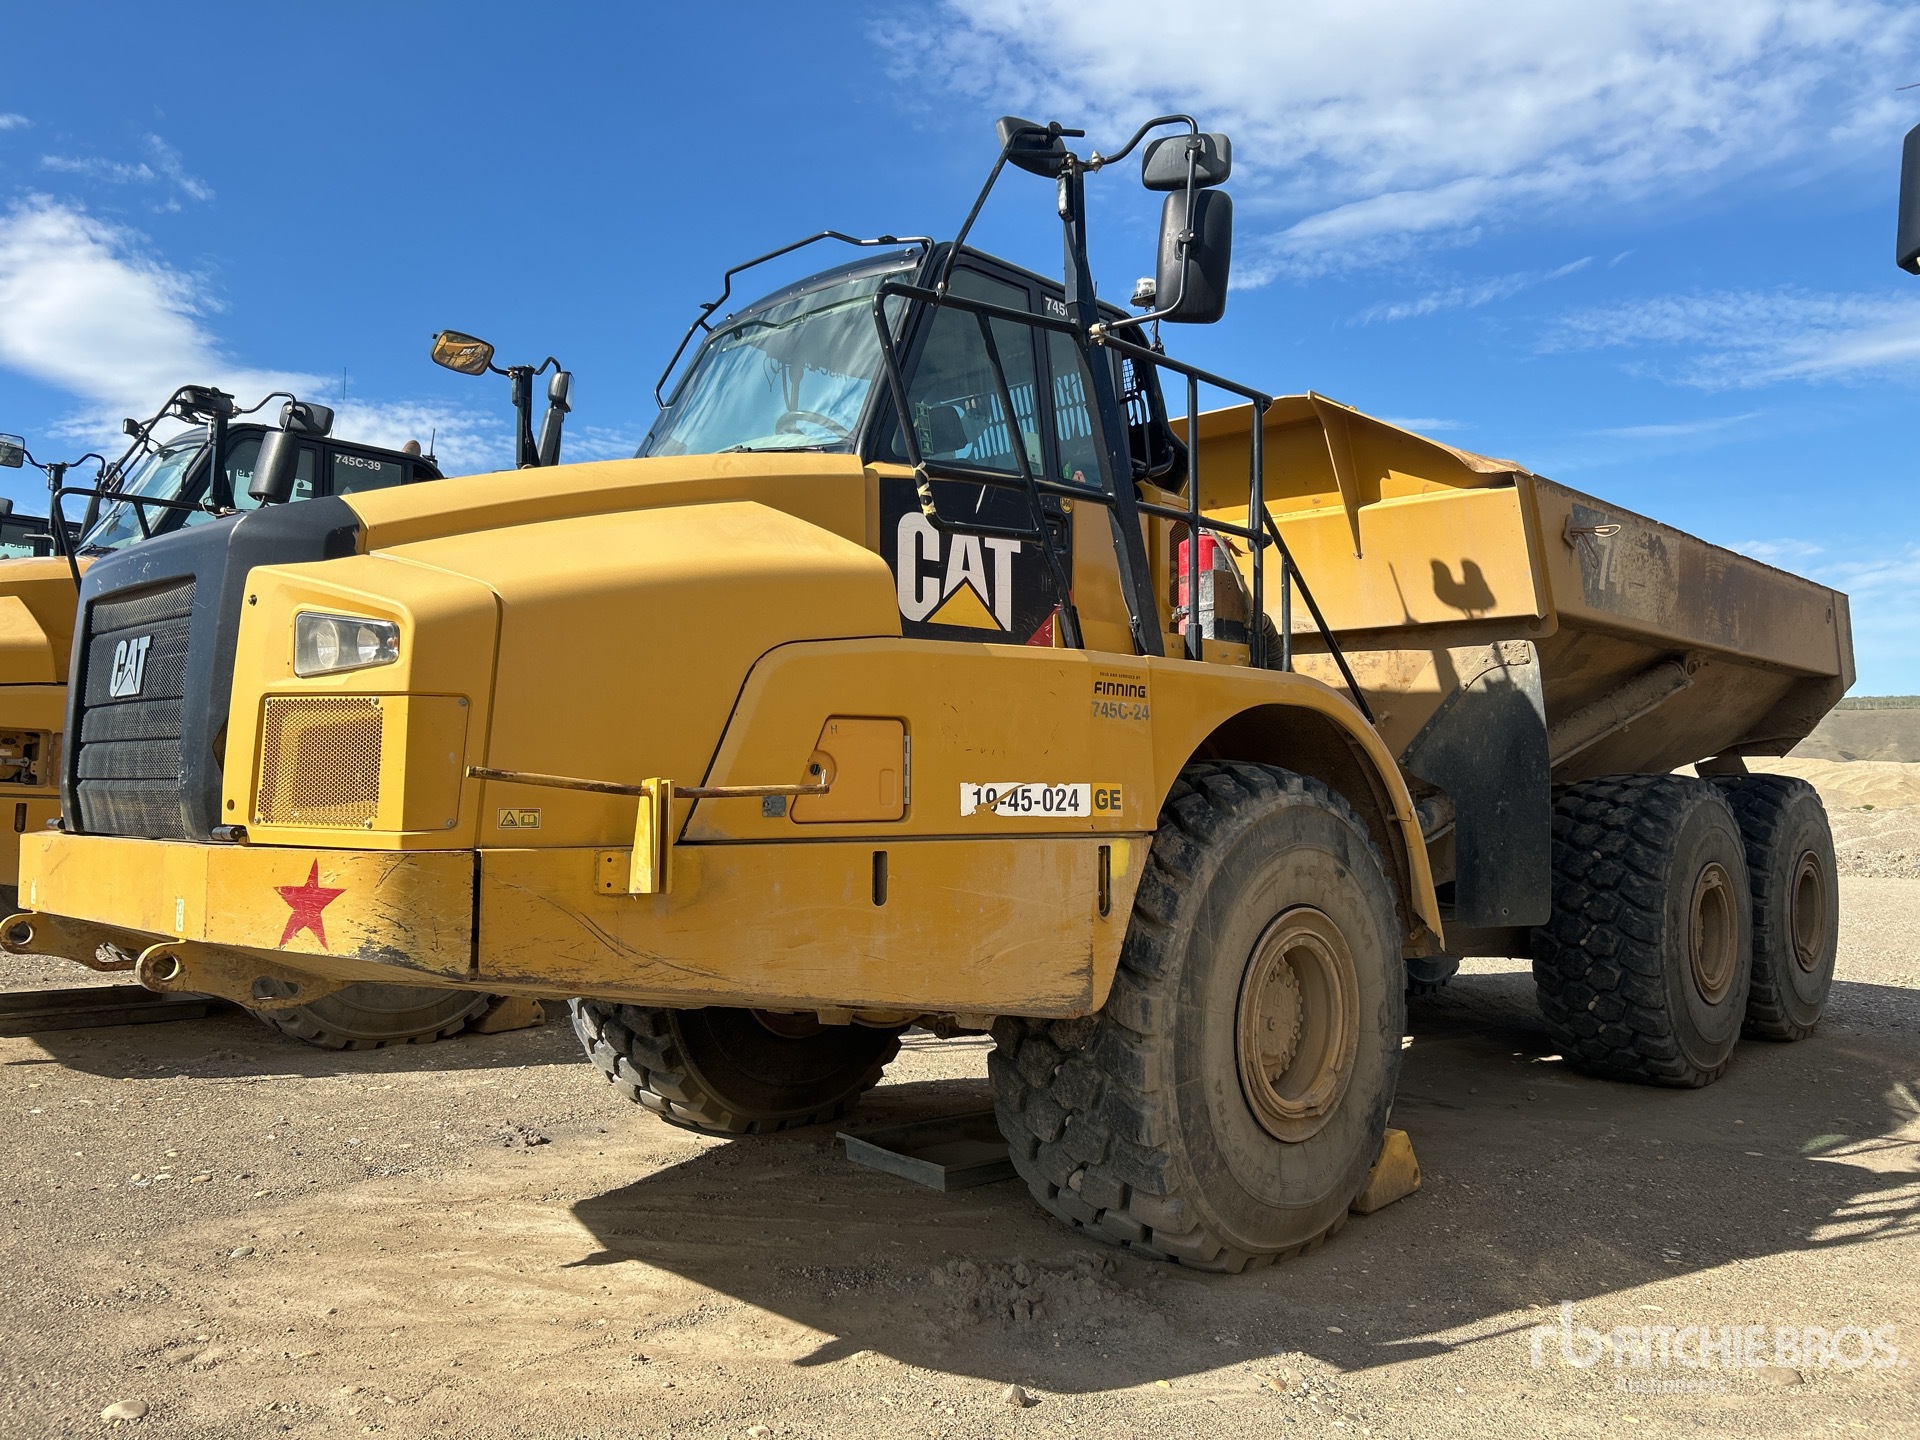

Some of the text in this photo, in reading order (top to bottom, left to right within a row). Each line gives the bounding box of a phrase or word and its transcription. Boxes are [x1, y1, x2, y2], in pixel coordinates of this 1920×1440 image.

[1045, 297, 1069, 317] 745
[334, 454, 381, 471] 745C-39
[897, 512, 1021, 632] CAT
[109, 635, 151, 697] CAT
[1094, 681, 1146, 698] FINNING
[1092, 701, 1150, 720] 745C-24
[1094, 788, 1121, 810] GE
